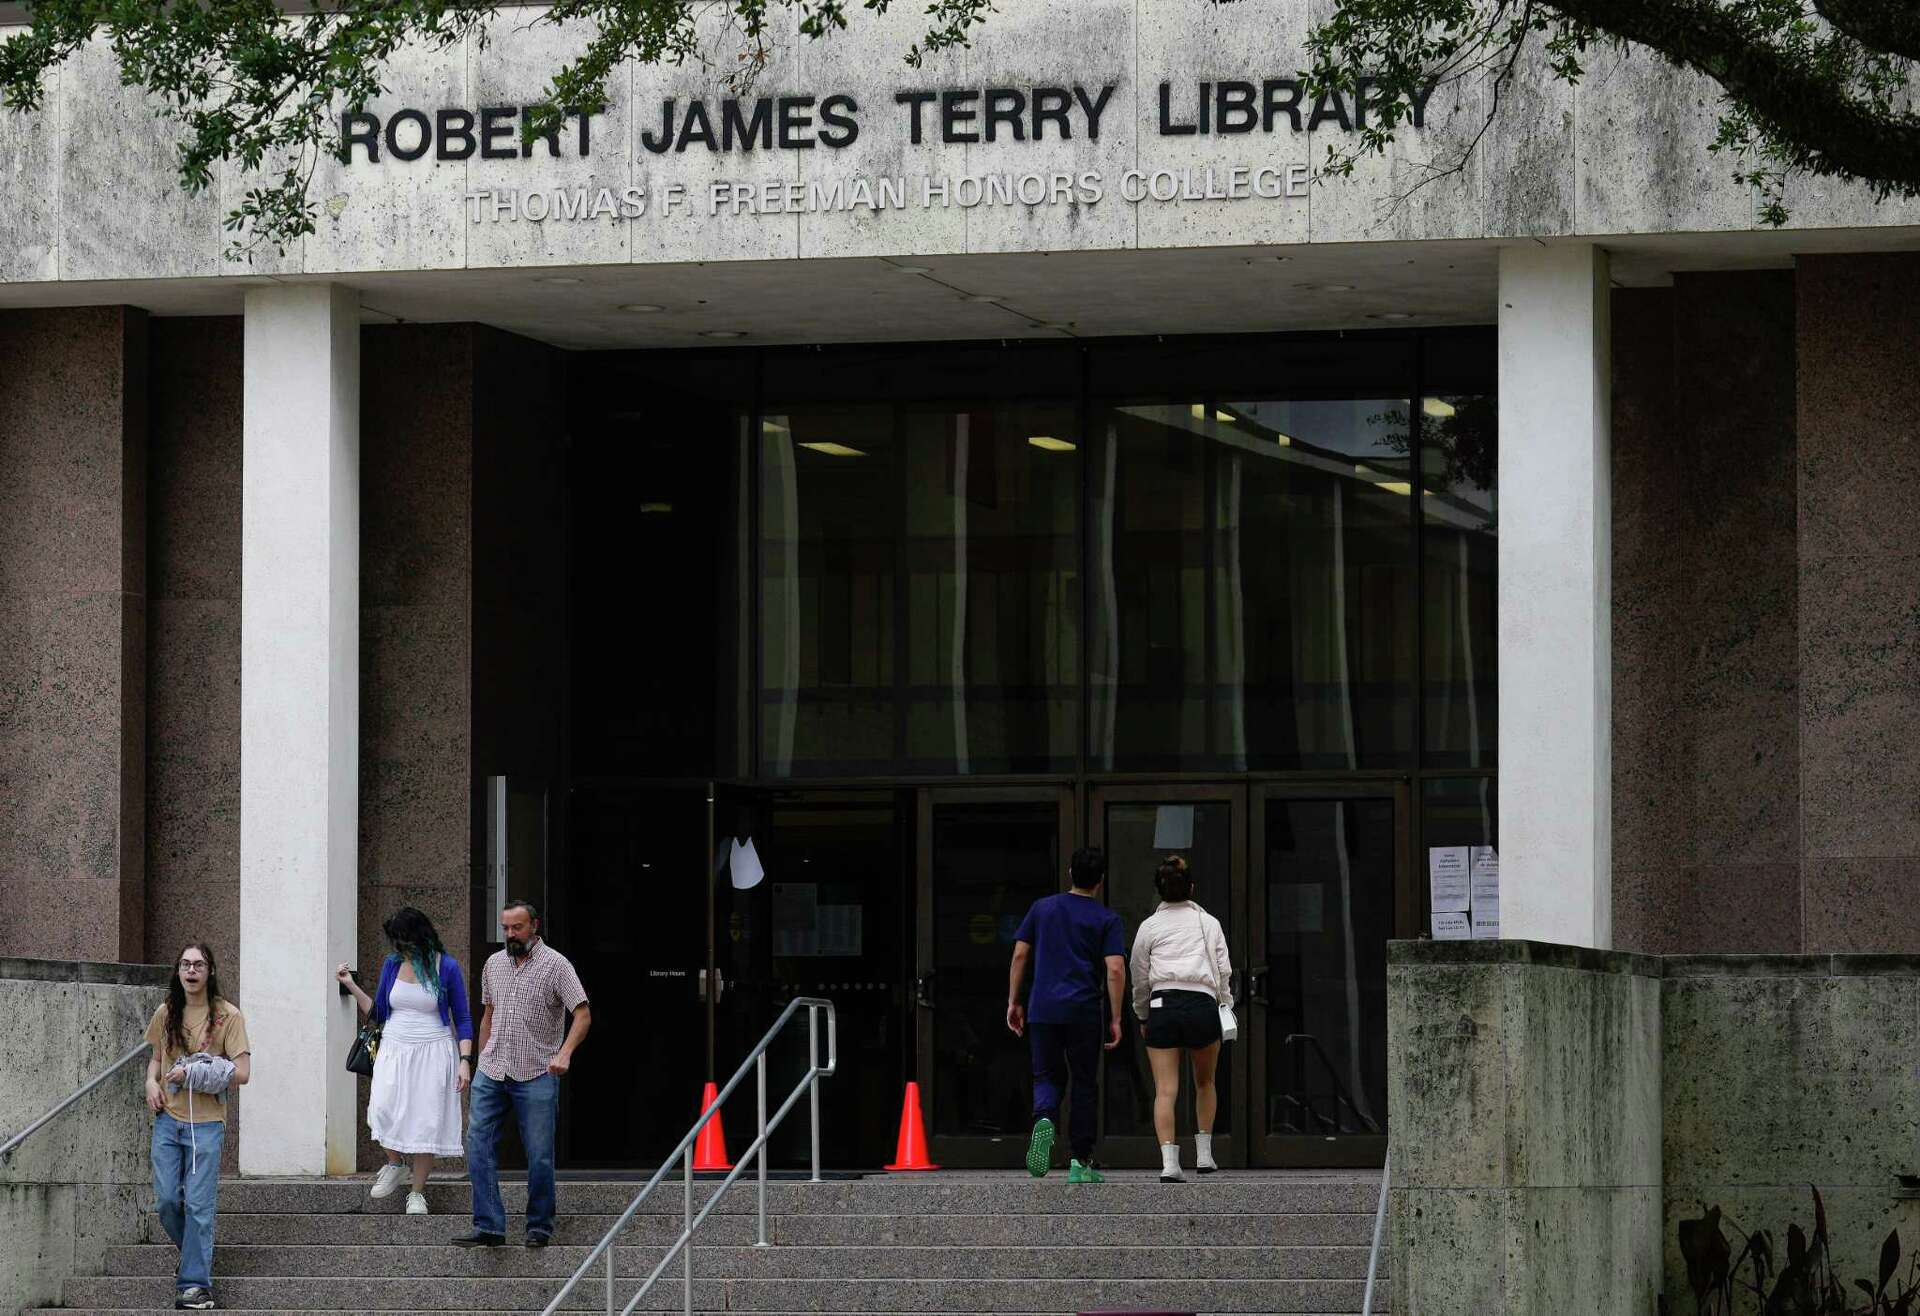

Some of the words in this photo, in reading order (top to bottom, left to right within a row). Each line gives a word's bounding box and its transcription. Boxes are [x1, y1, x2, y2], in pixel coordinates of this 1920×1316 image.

[342, 104, 606, 164] ROBERT
[641, 95, 860, 154] JAMES
[895, 86, 1115, 145] TERRY
[465, 186, 647, 223] THOMAS
[710, 176, 907, 216] FREEMAN
[923, 172, 1104, 208] HONORS
[1120, 163, 1308, 202] COLLEGE
